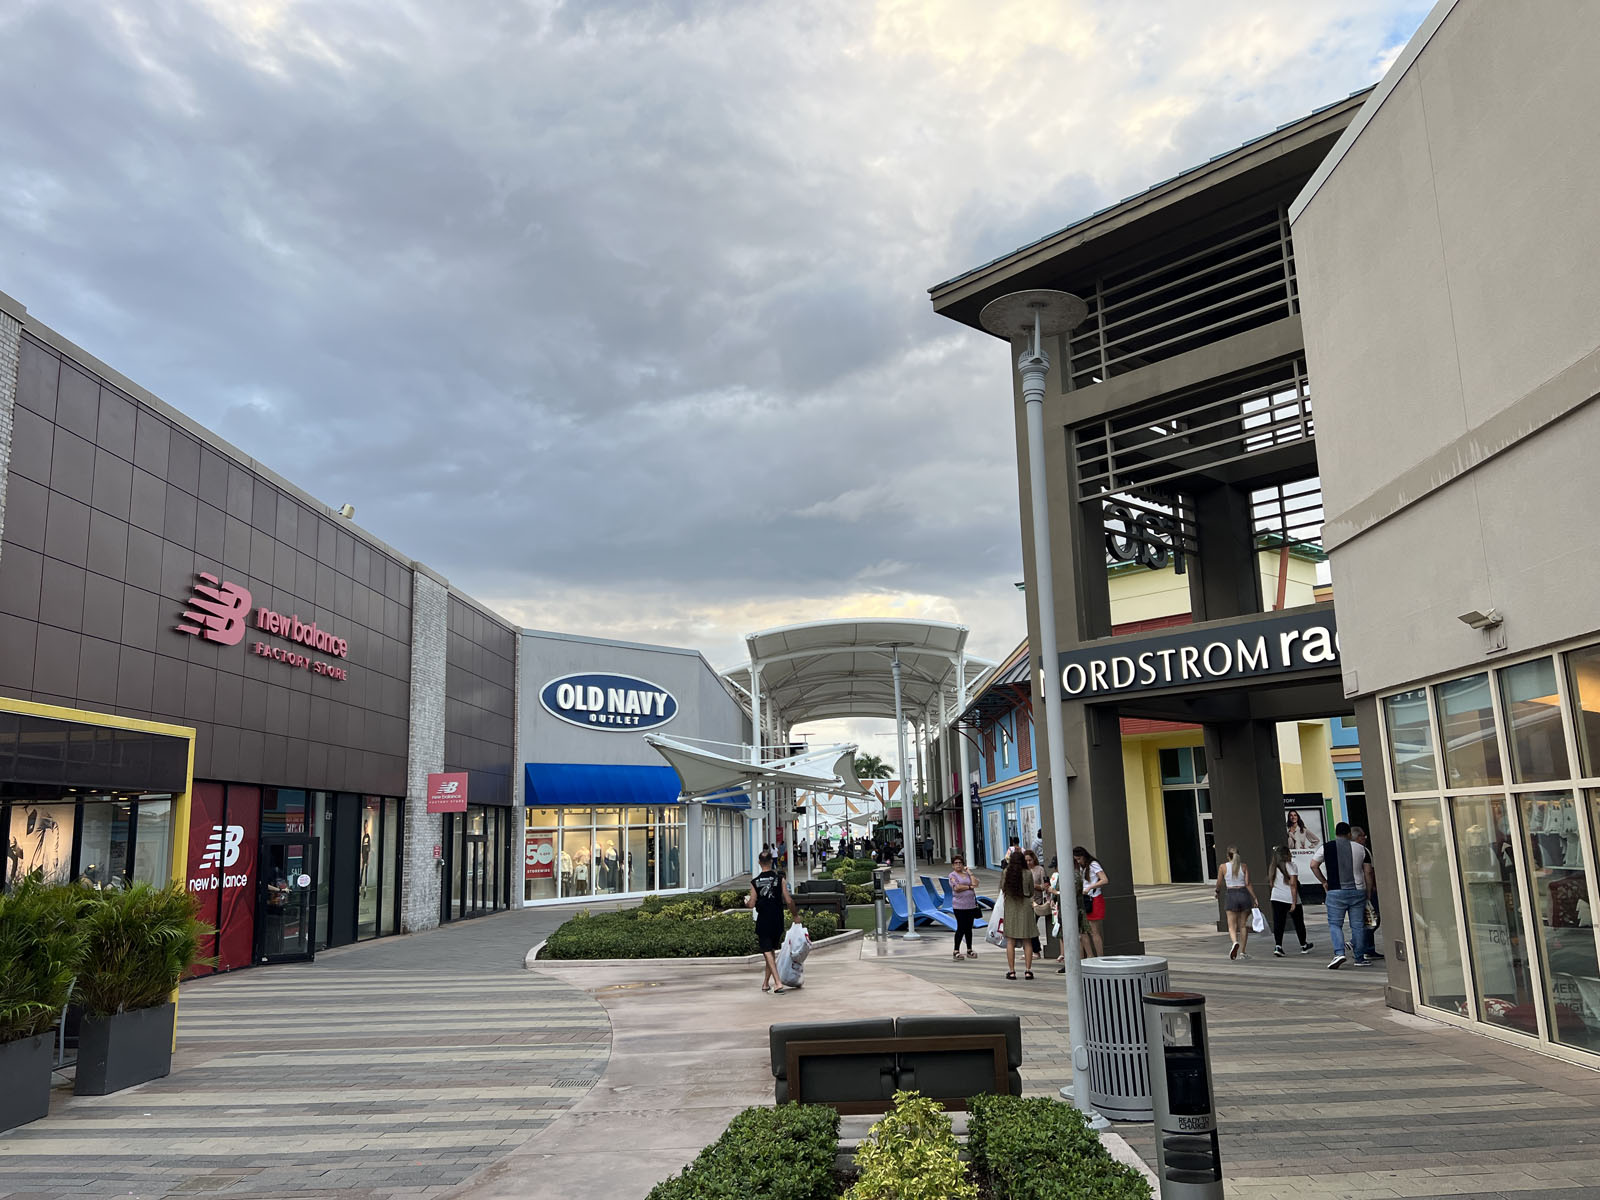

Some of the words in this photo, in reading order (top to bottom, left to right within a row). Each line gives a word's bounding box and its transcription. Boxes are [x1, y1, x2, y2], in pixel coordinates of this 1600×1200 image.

[256, 607, 291, 637] new
[291, 614, 348, 658] balance
[1280, 625, 1341, 667] ra
[255, 641, 311, 670] FACTORY
[313, 660, 348, 681] STORE
[556, 682, 604, 712] OLD
[607, 687, 668, 717] NAVY
[589, 713, 639, 725] OUTLET
[189, 877, 210, 892] new
